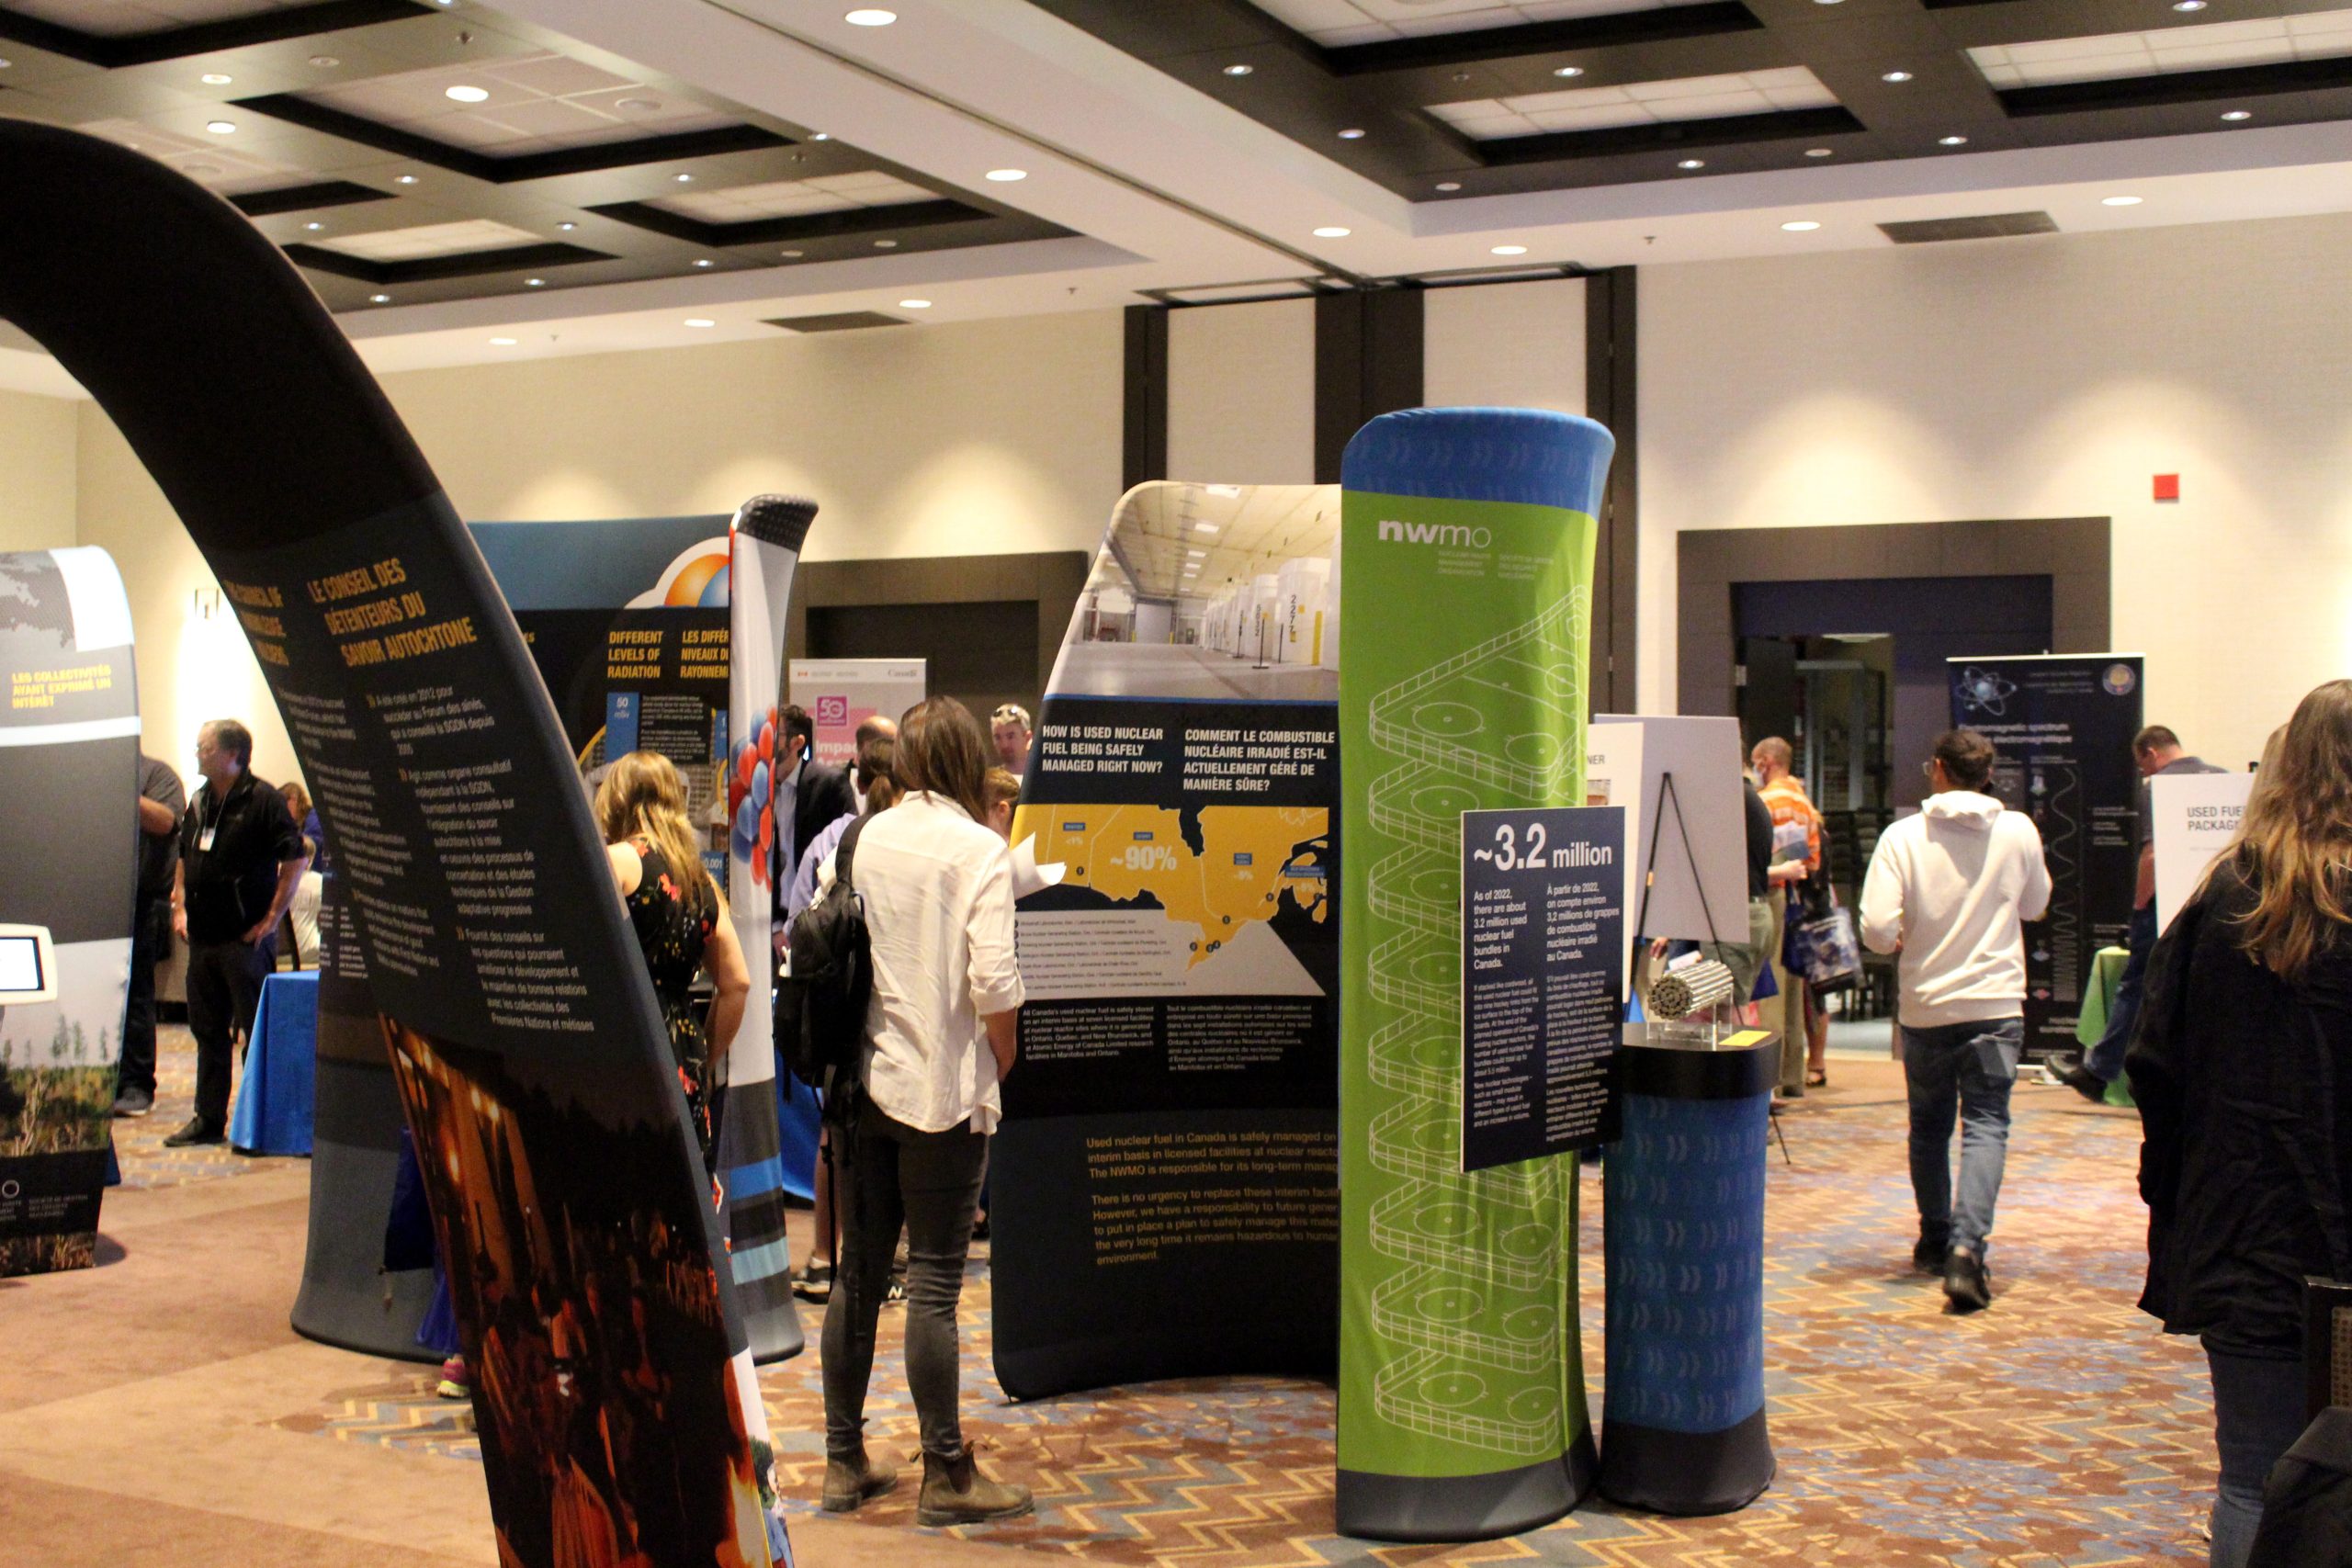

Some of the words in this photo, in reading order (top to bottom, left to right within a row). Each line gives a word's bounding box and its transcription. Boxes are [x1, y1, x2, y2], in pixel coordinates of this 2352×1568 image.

[1379, 520, 1491, 548] nwmo
[307, 580, 327, 604] LE
[322, 567, 379, 601] CONSEIL
[373, 558, 406, 588] DES
[324, 597, 403, 636] DÉTENTEURS
[401, 591, 426, 619] DU
[341, 638, 386, 668] SAVOIR
[384, 616, 478, 660] AUTOCHTONE
[609, 630, 663, 645] DIFFERENT
[682, 630, 699, 644] LES
[608, 648, 645, 661] LEVELS
[647, 648, 662, 661] OF
[681, 648, 718, 661] NIVEAUX
[607, 665, 662, 679] RADIATION
[1043, 725, 1068, 739] HOW
[1070, 726, 1081, 739] IS
[1084, 726, 1113, 739] USED
[1114, 727, 1164, 740] NUCLEAR
[1185, 728, 1240, 742] COMMENT
[1243, 730, 1256, 742] LE
[1259, 730, 1335, 744] COMBUSTIBLE
[1042, 742, 1069, 755] FUEL
[1070, 742, 1102, 755] BEING
[1105, 743, 1144, 756] SAFELY
[1184, 744, 1244, 758] NUCLÉAIRE
[1247, 745, 1291, 760] IRRADIÉ
[1293, 747, 1328, 760] EST-IL
[1042, 759, 1094, 773] MANAGED
[1097, 760, 1129, 773] RIGHT
[1131, 761, 1163, 773] NOW?
[1183, 761, 1267, 775] ACTUELLEMENT
[1269, 761, 1298, 776] GÉRÉ
[1300, 763, 1316, 776] DE
[1182, 776, 1232, 791] MANIÈRE
[1235, 777, 1271, 792] SÛRE?
[2188, 807, 2217, 818] USED
[1474, 822, 1546, 871] ~3.2
[1553, 841, 1612, 868] million
[1110, 845, 1177, 872] ~90%
[1474, 890, 1484, 901] As
[1485, 889, 1492, 900] of
[1493, 888, 1513, 900] 2022,
[1547, 883, 1553, 896] À
[1553, 885, 1571, 897] partir
[1572, 884, 1581, 894] de
[1474, 905, 1492, 915] there
[1493, 904, 1505, 914] are
[1506, 901, 1527, 913] about
[1547, 900, 1556, 908] on
[1556, 897, 1582, 908] compte
[1583, 896, 1607, 906] environ
[1474, 918, 1485, 929] 3.2
[1486, 916, 1510, 928] million
[1510, 914, 1528, 926] used
[1557, 910, 1583, 921] millions
[1584, 908, 1593, 919] de
[1593, 908, 1620, 920] grappes
[1474, 931, 1500, 942] nuclear
[1500, 928, 1514, 940] fuel
[1547, 926, 1555, 935] de
[1556, 921, 1597, 934] combustible
[1474, 944, 1502, 956] bundles
[1502, 943, 1510, 953] in
[1474, 958, 1503, 970] Canada.
[1547, 953, 1555, 962] au
[1087, 1136, 1112, 1148] Used
[1114, 1135, 1150, 1146] nuclear
[1153, 1134, 1172, 1145] fuel
[1175, 1134, 1184, 1143] in
[1186, 1132, 1226, 1144] Canada
[1228, 1132, 1238, 1142] is
[1240, 1131, 1271, 1144] safely
[1272, 1131, 1320, 1144] managed
[1323, 1134, 1336, 1142] on
[1088, 1151, 1121, 1164] interim
[1124, 1149, 1150, 1161] basis
[1152, 1149, 1162, 1159] in
[1164, 1147, 1206, 1158] licensed
[1209, 1146, 1250, 1157] facilities
[1253, 1146, 1264, 1156] at
[1267, 1146, 1304, 1156] nuclear
[1089, 1168, 1107, 1179] The
[1110, 1164, 1145, 1176] NWMO
[1148, 1165, 1157, 1175] is
[1159, 1162, 1217, 1176] responsible
[1220, 1161, 1234, 1172] for
[1251, 1161, 1302, 1173] long-term
[1091, 1194, 1119, 1205] There
[1122, 1193, 1131, 1203] is
[1132, 1192, 1145, 1202] no
[1148, 1190, 1187, 1202] urgency
[1190, 1189, 1201, 1199] to
[1204, 1188, 1240, 1200] replace
[1092, 1209, 1137, 1221] However,
[1140, 1208, 1155, 1217] we
[1158, 1205, 1182, 1215] have
[1183, 1205, 1191, 1213] a
[1193, 1201, 1260, 1215] responsibility
[1262, 1201, 1273, 1212] to
[1275, 1201, 1306, 1212] future
[1094, 1225, 1104, 1235] to
[1106, 1224, 1123, 1235] put
[1125, 1223, 1135, 1233] in
[1136, 1221, 1164, 1234] place
[1166, 1222, 1173, 1230] a
[1175, 1219, 1197, 1231] plan
[1199, 1218, 1210, 1228] to
[1213, 1217, 1242, 1229] safely
[1245, 1218, 1286, 1228] manage
[1095, 1239, 1111, 1250] the
[1113, 1239, 1134, 1250] very
[1136, 1235, 1159, 1247] long
[1160, 1234, 1182, 1245] time
